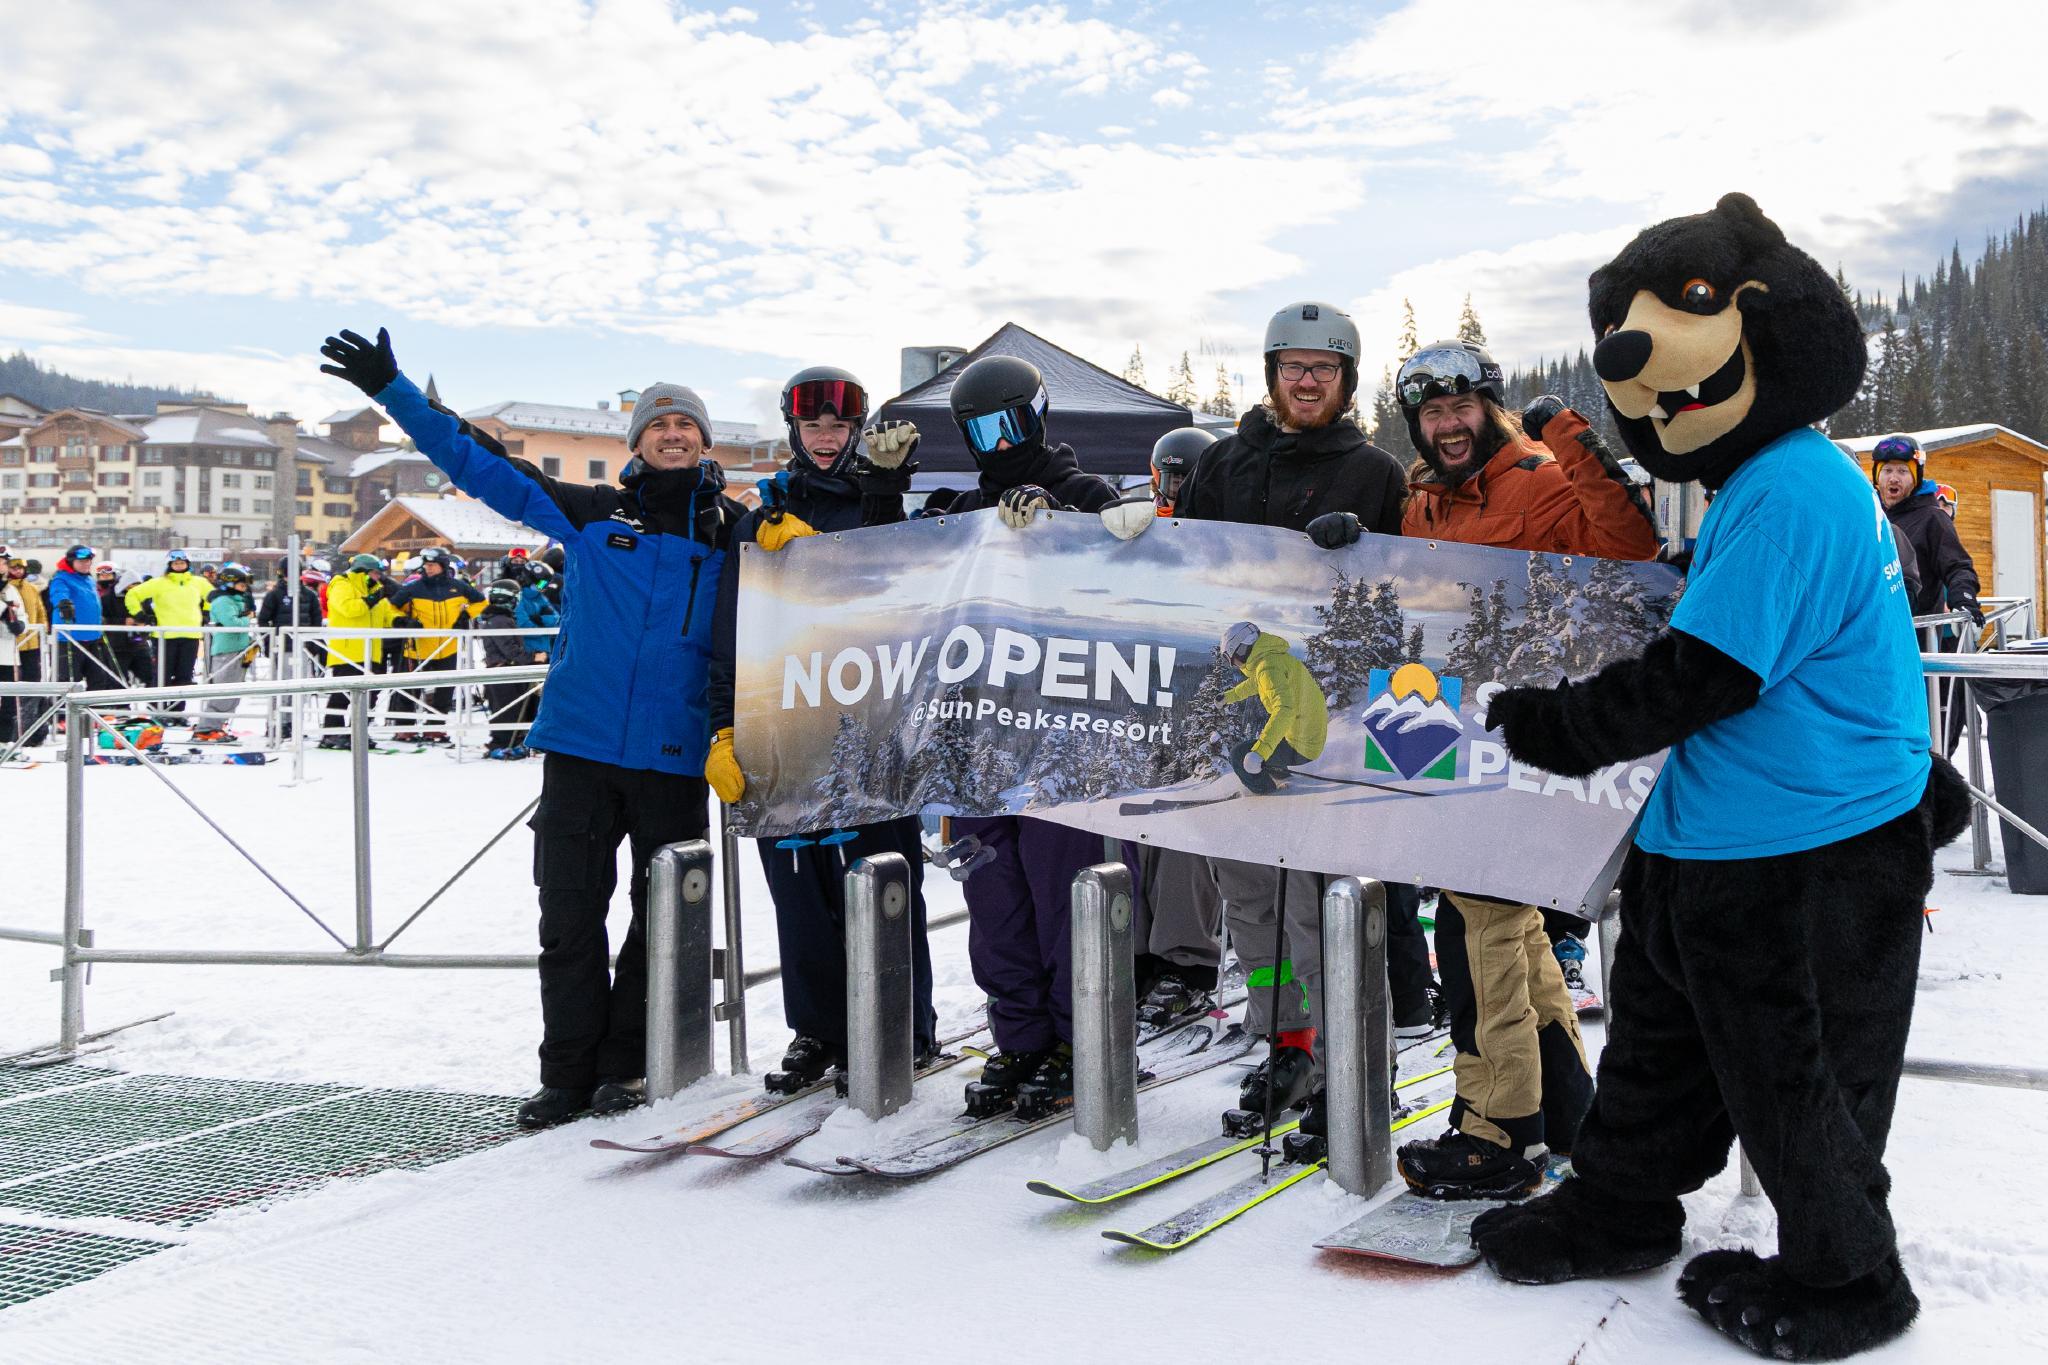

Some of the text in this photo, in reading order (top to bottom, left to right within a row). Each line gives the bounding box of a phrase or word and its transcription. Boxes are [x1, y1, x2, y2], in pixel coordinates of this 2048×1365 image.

[1328, 337, 1353, 350] GIRO
[782, 624, 1177, 710] NOW OPEN!
[910, 698, 1172, 745] @SunPeaksResort
